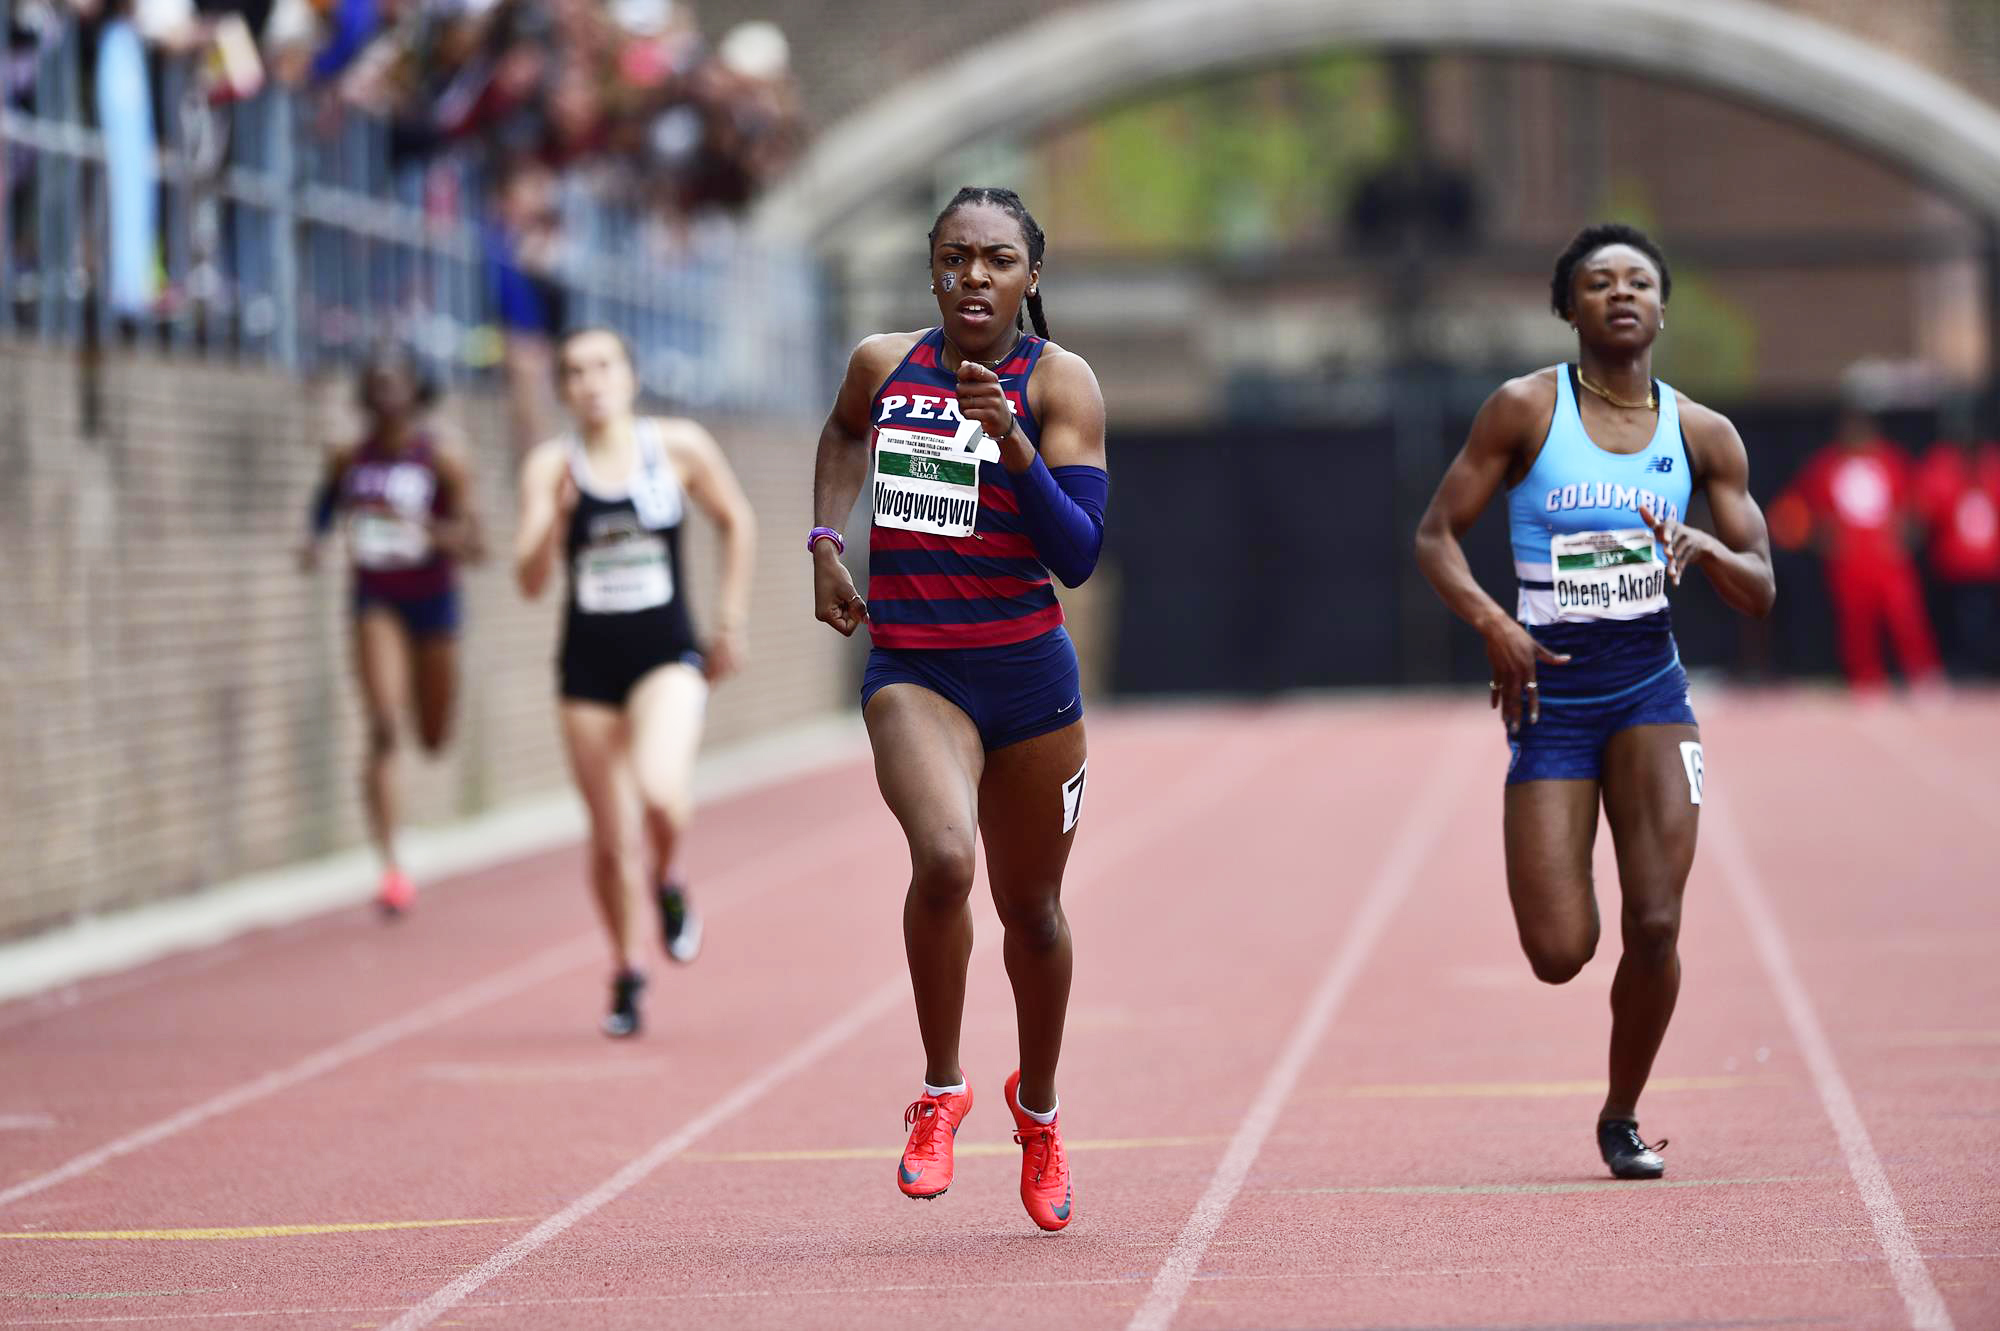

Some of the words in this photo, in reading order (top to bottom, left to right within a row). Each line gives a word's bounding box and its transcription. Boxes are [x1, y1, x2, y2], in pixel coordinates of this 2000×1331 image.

[916, 471, 940, 480] LEAGUE
[917, 461, 940, 474] IVY
[875, 481, 975, 528] Nwogwugwu
[1545, 481, 1679, 522] COLUMBIA
[1559, 569, 1663, 608] Obeng-Akrofi
[1067, 766, 1086, 824] 7
